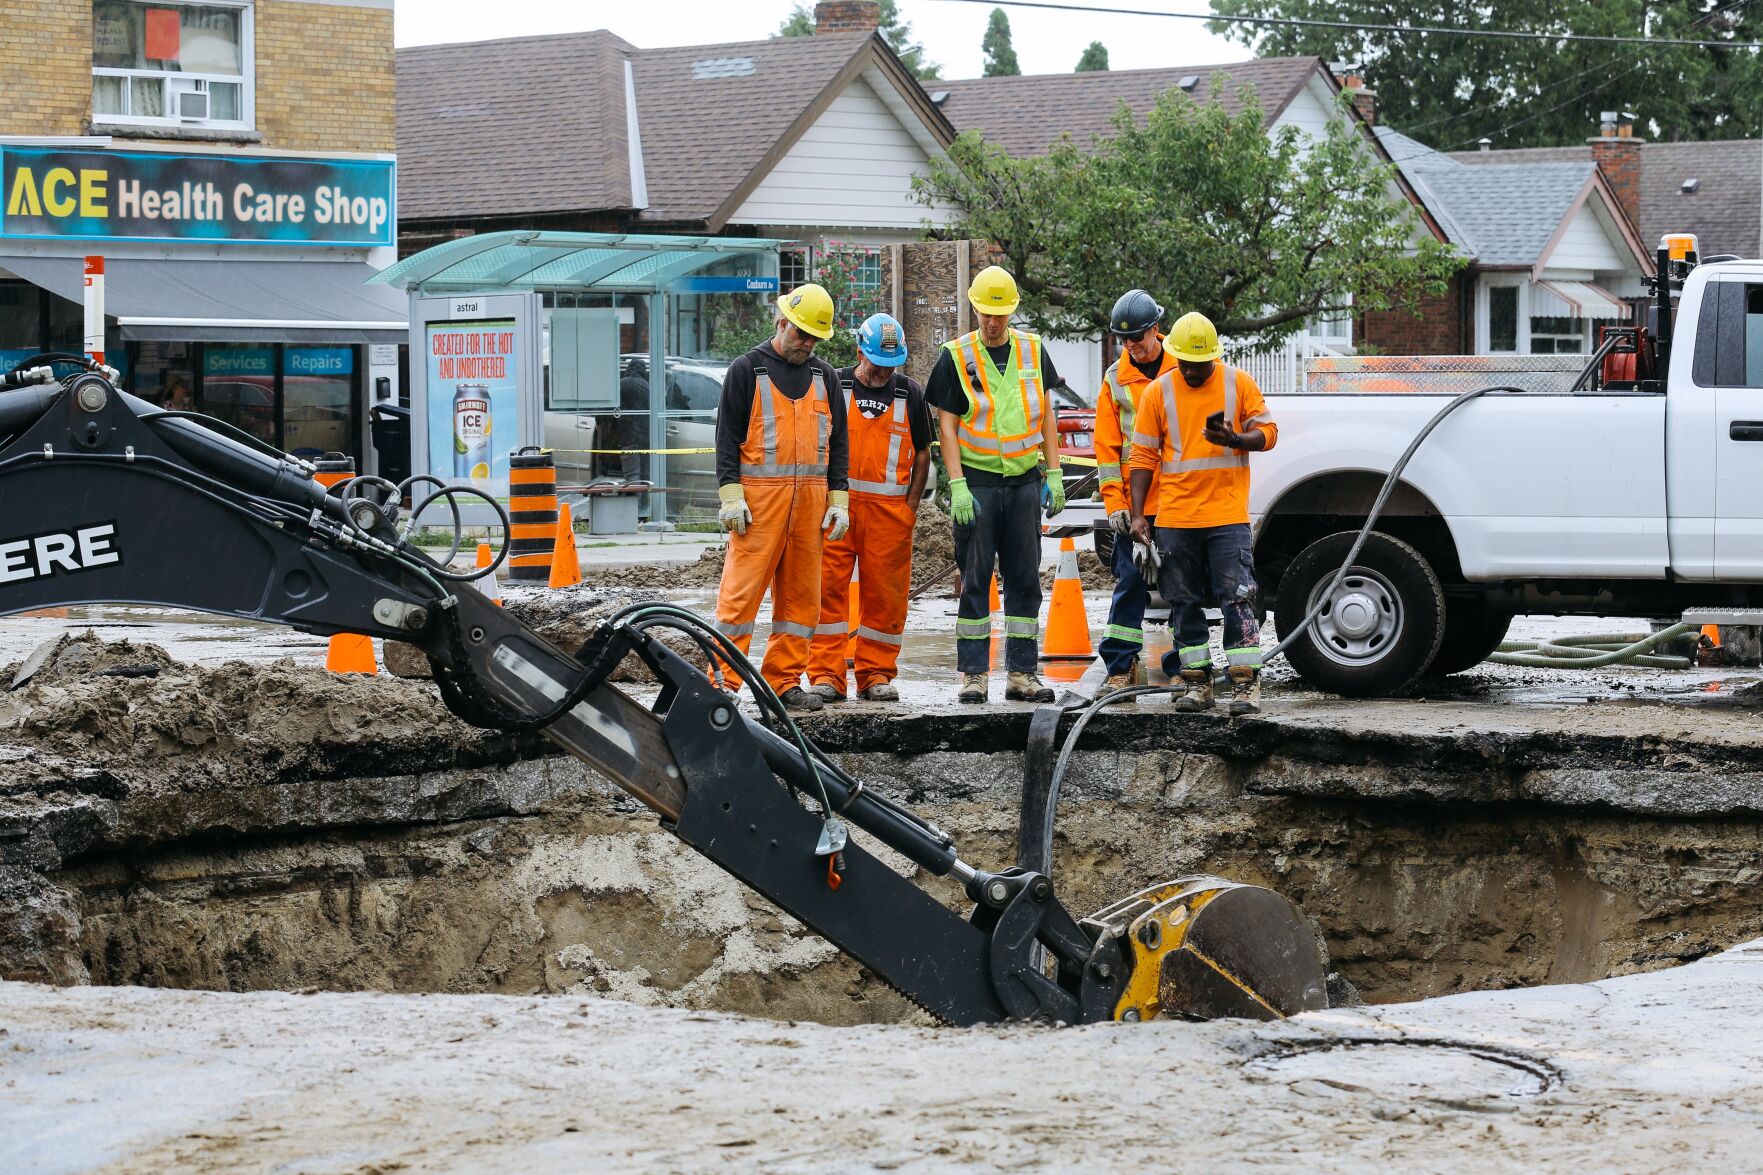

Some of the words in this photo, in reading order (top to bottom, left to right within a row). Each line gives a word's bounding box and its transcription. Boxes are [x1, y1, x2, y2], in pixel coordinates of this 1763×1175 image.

[7, 167, 109, 218] ACE
[118, 179, 224, 221] Health
[233, 183, 306, 223] Care
[313, 186, 388, 234] Shop
[456, 302, 478, 312] astral
[432, 334, 464, 356] CREATED
[466, 333, 481, 355] FOR
[482, 332, 497, 354] THE
[498, 332, 514, 354] HOT
[209, 355, 268, 371] Services
[292, 355, 342, 373] Repairs
[440, 357, 454, 379] AND
[456, 356, 507, 379] UNBOTHERED.
[463, 414, 482, 428] ICE
[0, 524, 119, 582] ERE
